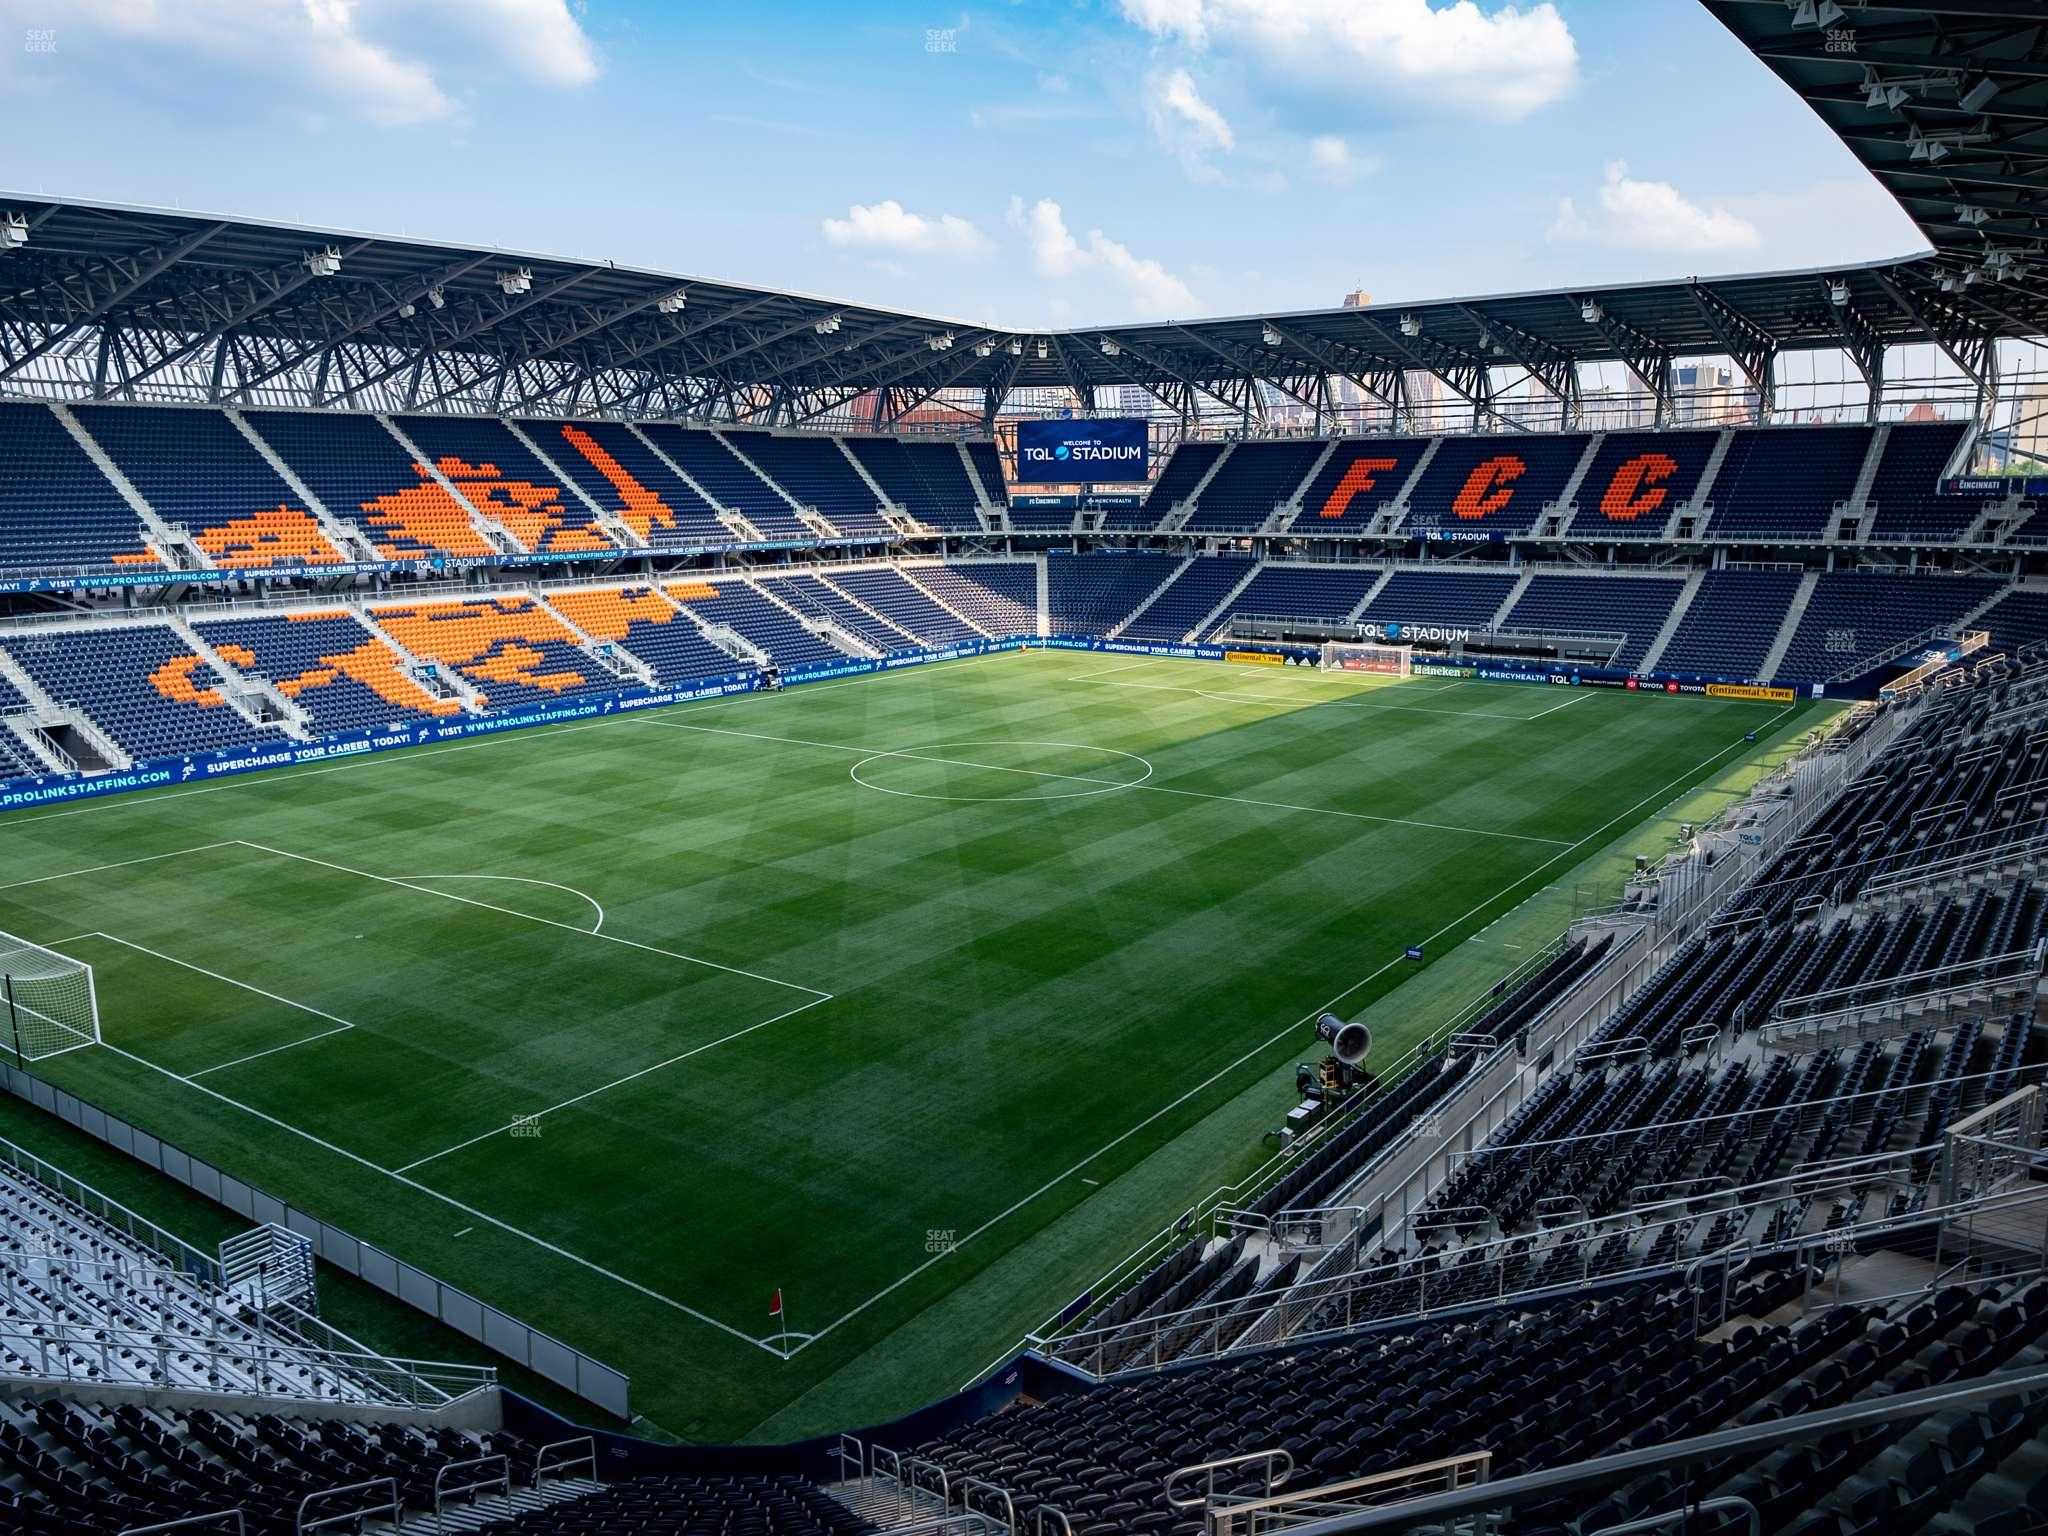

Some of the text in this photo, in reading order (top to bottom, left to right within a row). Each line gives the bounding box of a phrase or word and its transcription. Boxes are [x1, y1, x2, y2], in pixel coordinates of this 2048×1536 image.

[1024, 447, 1141, 461] TQL STADIUM
[1959, 480, 2000, 489] CINCINNATI
[1426, 532, 1490, 540] TQL STADIUM
[415, 558, 486, 570] TQL STADIUM
[513, 554, 529, 562] VISIT
[244, 563, 385, 578] SUPERCHARGE YOUR CAREER TODAY!
[50, 572, 220, 589] VISIT WWW.PROLINKSTAFFING.COM
[1356, 623, 1469, 642] TQL STADIUM
[1104, 643, 1222, 657] SUPERCHARGE YOUR CAREER TODAY!
[1413, 664, 1461, 677] Heineken
[1489, 672, 1546, 681] MERCYHEALTH
[1550, 675, 1570, 685] TQL
[620, 683, 748, 709] SUPERCHARGE YOUR CAREER TODAY!
[1710, 684, 1791, 698] Continental TIRE
[437, 705, 598, 737] VISIT WWW.PROLINKSTAFFING.COM
[207, 751, 292, 774] SUPERCHARGE
[295, 748, 327, 760] YOUR
[328, 739, 370, 755] CAREER
[372, 733, 410, 748] TODAY!
